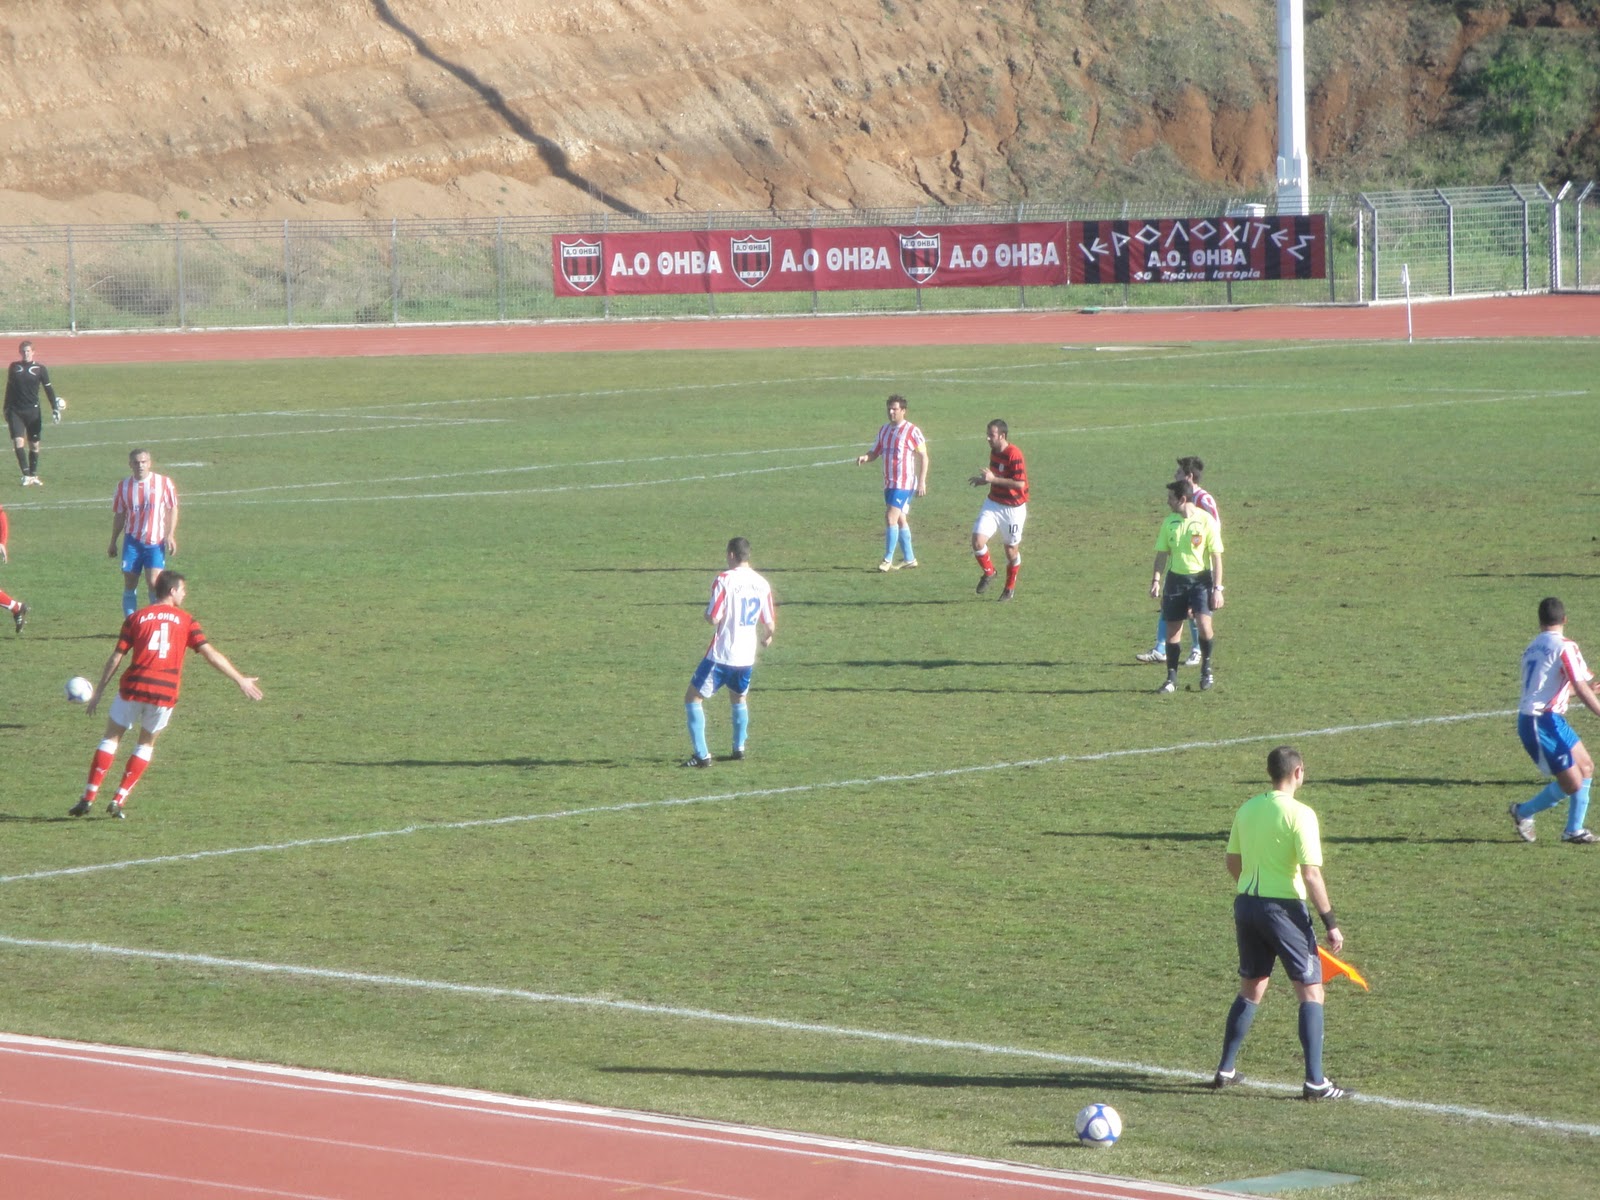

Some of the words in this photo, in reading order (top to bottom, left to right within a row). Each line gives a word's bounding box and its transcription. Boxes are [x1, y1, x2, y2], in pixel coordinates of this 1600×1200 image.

[1078, 220, 1316, 262] ΙΕΡΟΛΟΧΙΤΕΣ
[657, 250, 723, 275] ΘΗΒΑ
[826, 246, 892, 272] ΘΗΒΑ
[995, 242, 1060, 267] ΘΗΒΑ
[1192, 248, 1247, 266] ΘΗΒΑ
[1008, 524, 1019, 534] 10
[740, 596, 761, 627] 12
[147, 622, 171, 659] 4
[1526, 660, 1538, 689] 7
